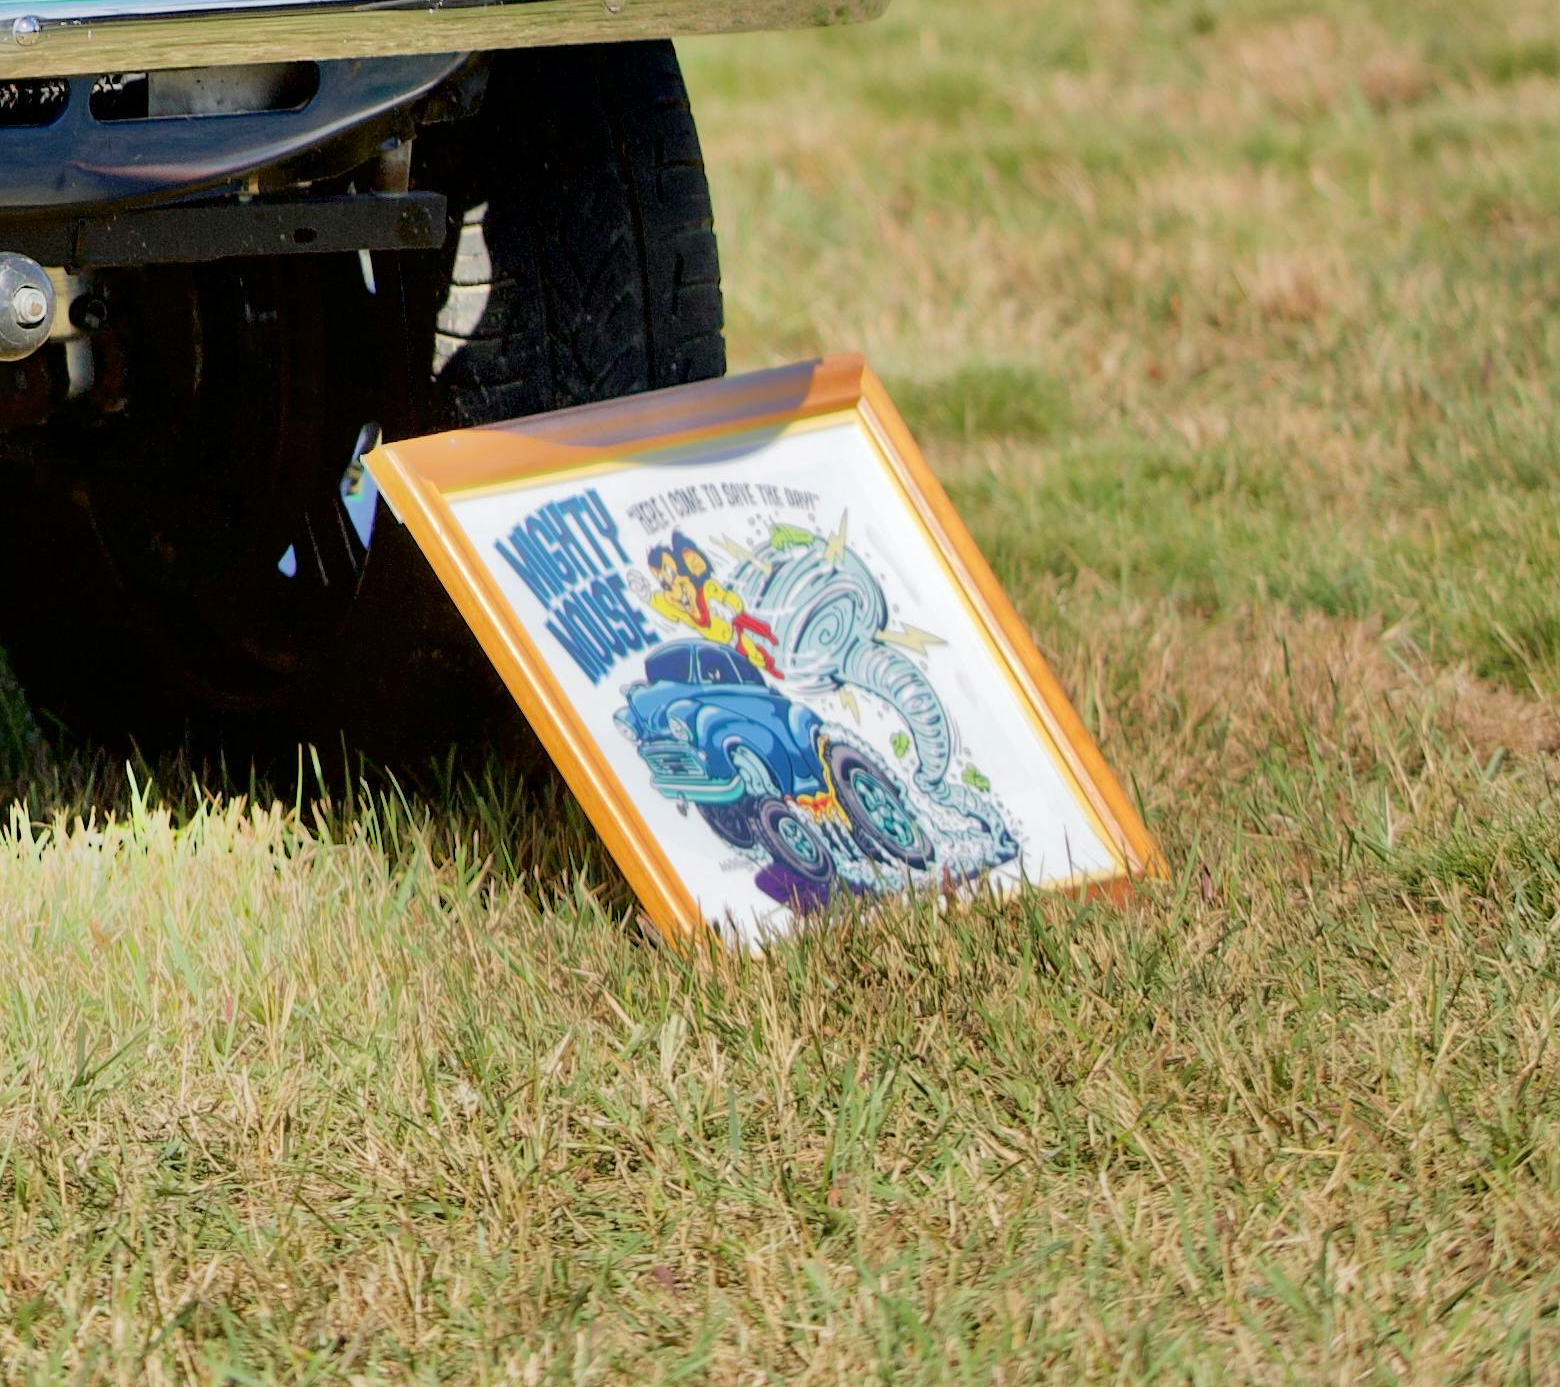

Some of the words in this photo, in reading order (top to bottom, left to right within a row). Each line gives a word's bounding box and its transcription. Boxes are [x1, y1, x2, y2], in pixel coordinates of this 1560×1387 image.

[493, 487, 632, 611] MIGHTY
[700, 482, 724, 515] TO
[721, 481, 757, 508] SAVE
[754, 483, 785, 508] THE
[544, 572, 663, 687] MOUSE
